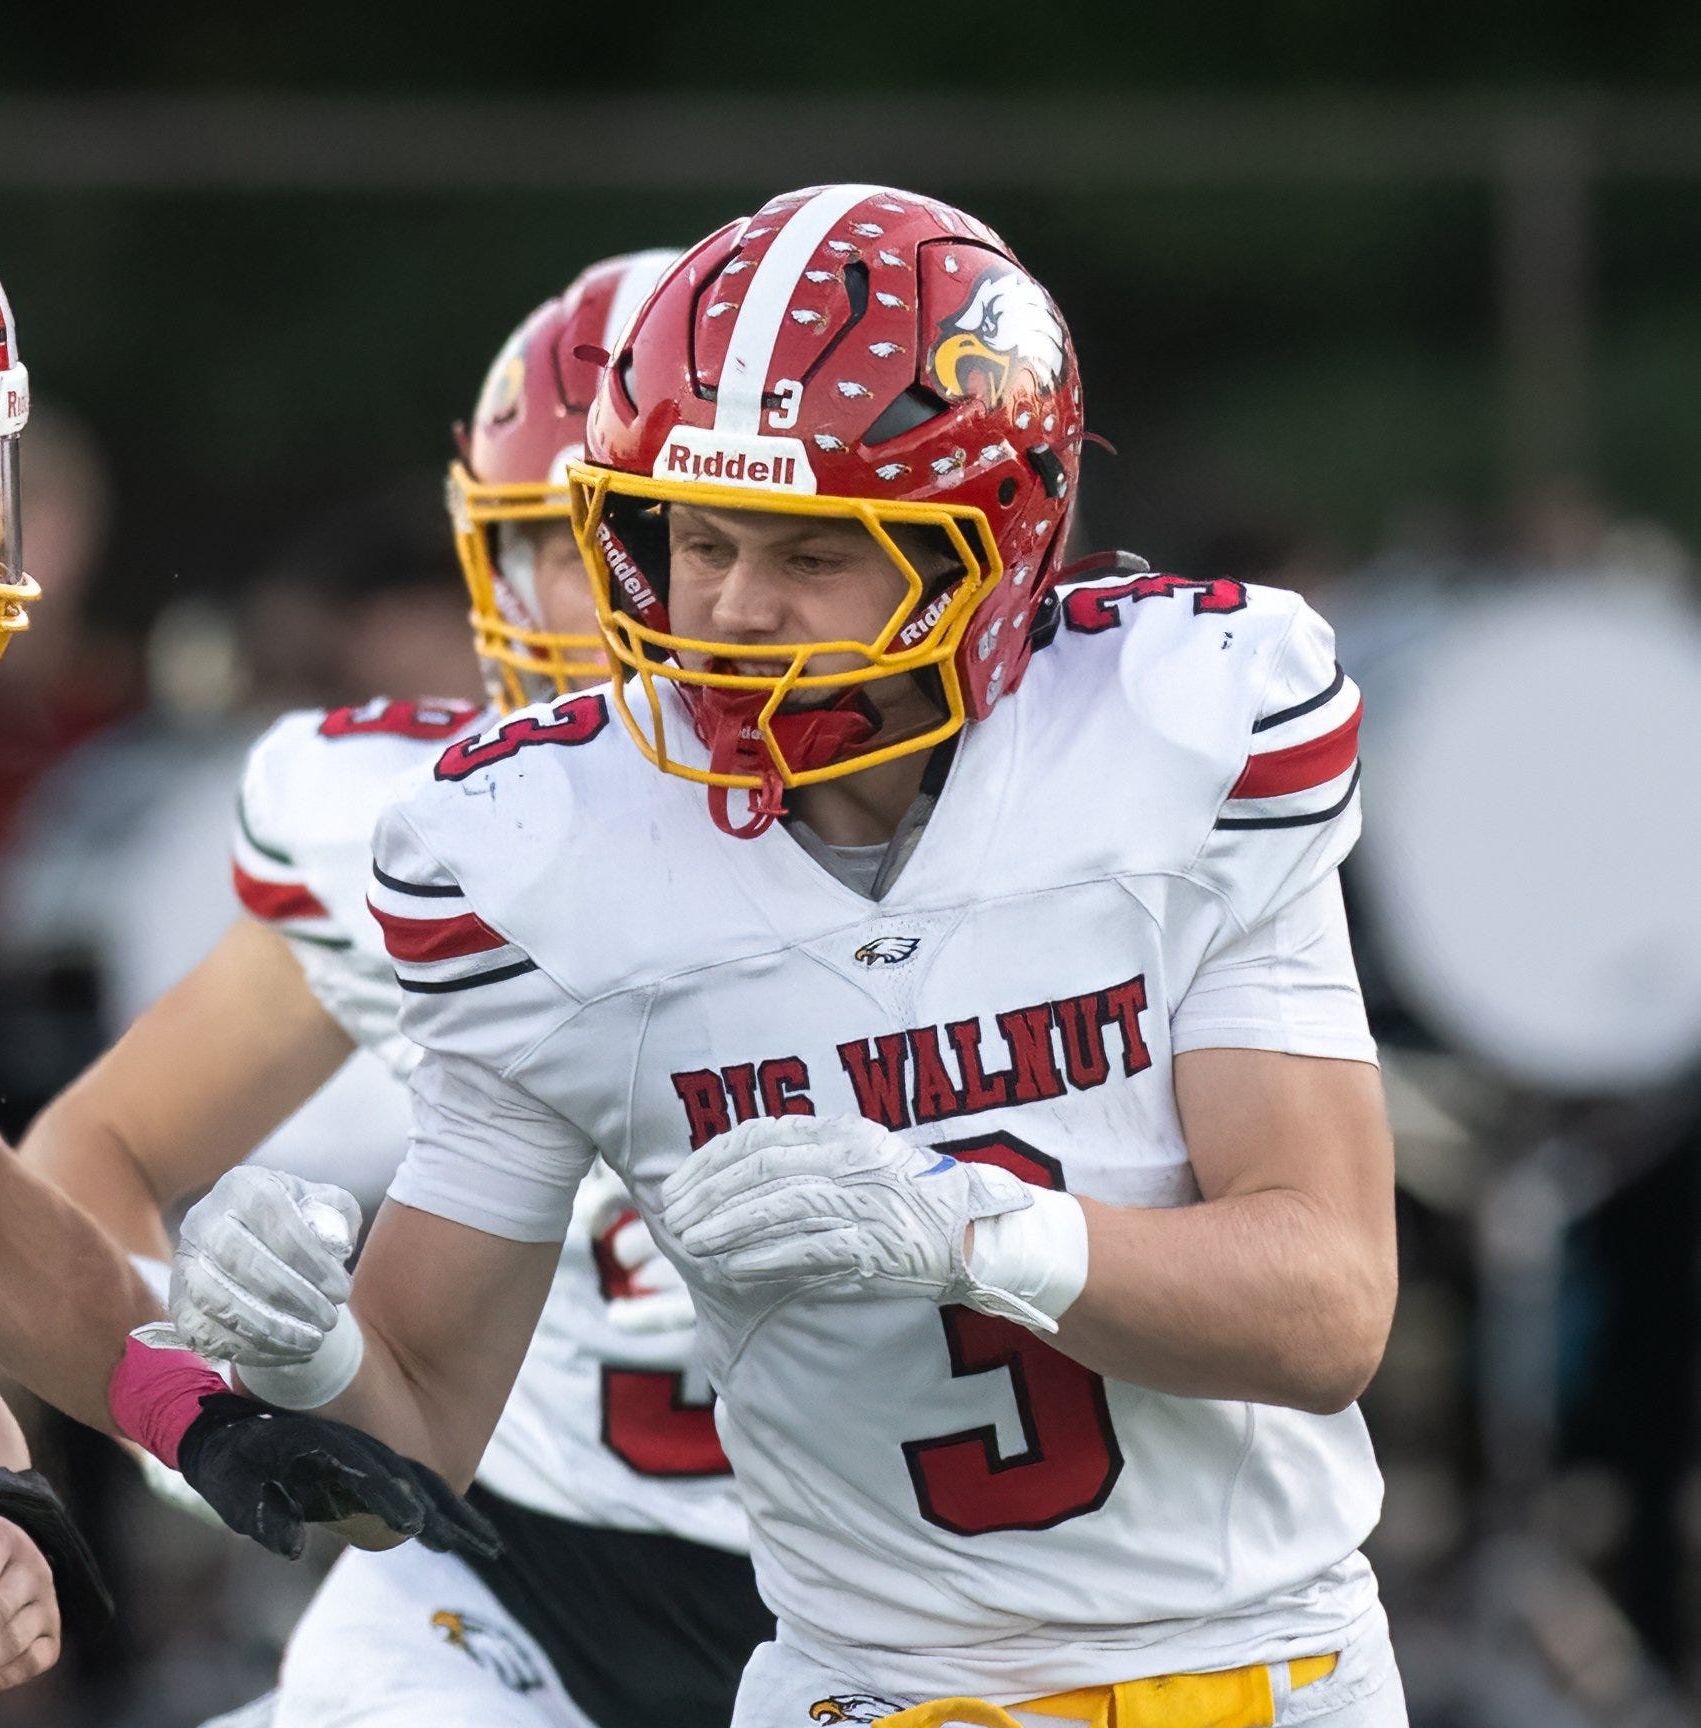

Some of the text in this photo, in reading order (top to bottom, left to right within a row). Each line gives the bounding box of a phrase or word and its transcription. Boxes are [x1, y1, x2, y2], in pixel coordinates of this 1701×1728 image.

[767, 378, 805, 430] 3
[667, 443, 796, 486] Riddell
[595, 521, 657, 611] Riddell
[433, 693, 611, 782] 3
[670, 984, 1153, 1151] BIG WALNUT
